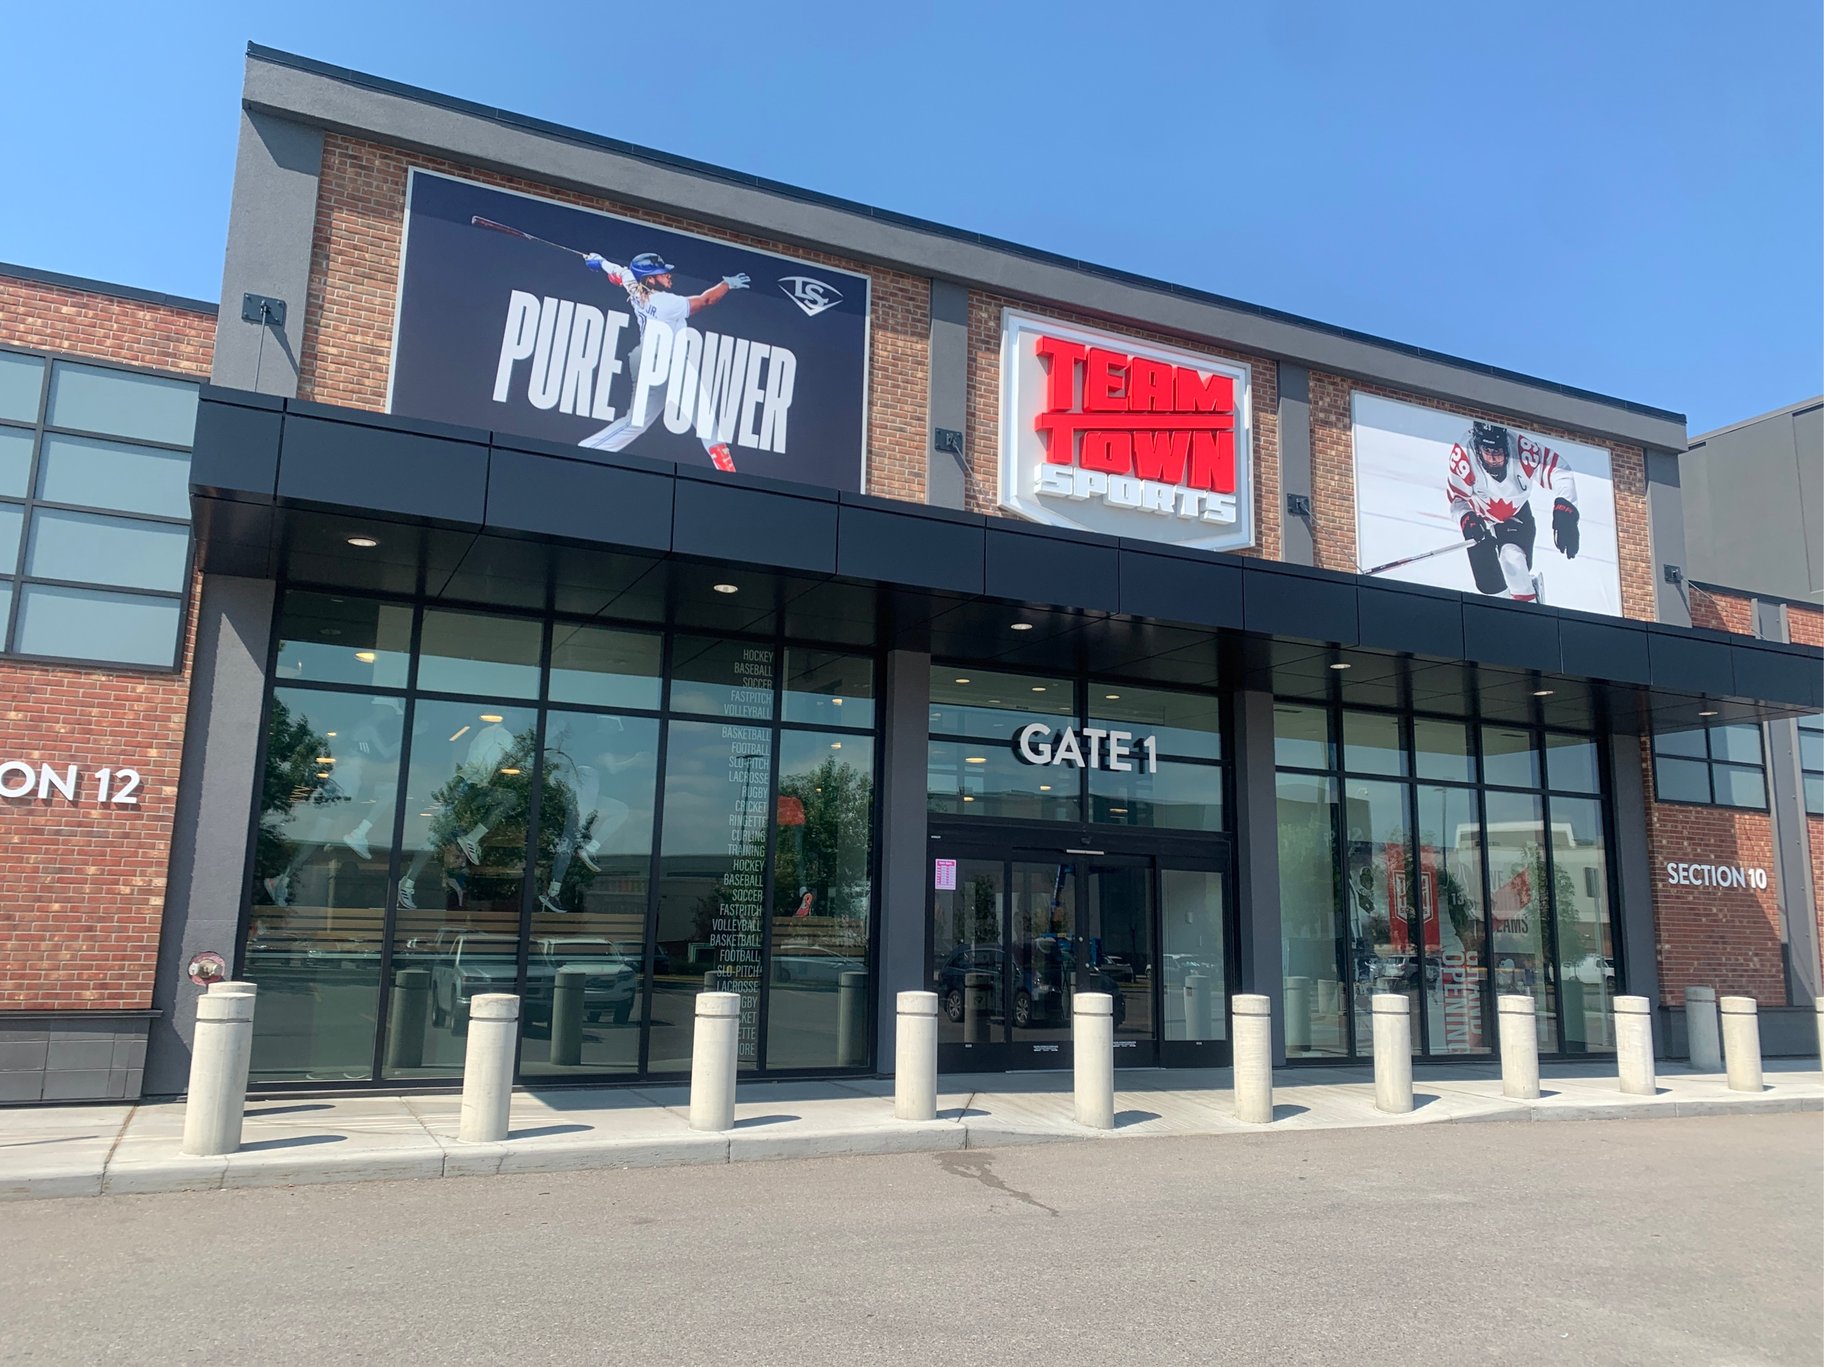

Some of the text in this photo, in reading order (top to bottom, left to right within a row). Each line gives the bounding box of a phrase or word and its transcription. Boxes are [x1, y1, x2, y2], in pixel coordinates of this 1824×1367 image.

[492, 290, 797, 455] PURE POWER
[1035, 336, 1235, 413] TEAM
[1034, 413, 1236, 494] TOWN
[1450, 447, 1470, 479] 29
[1034, 462, 1236, 525] SPORTS
[743, 649, 774, 663] HOCKEY
[734, 662, 773, 677] BASEBALL
[742, 677, 773, 690] SOCCER
[731, 690, 772, 704] FASTPITCH
[724, 704, 772, 719] VOLLEYBALL
[722, 727, 771, 741] BASKETBALL
[731, 741, 770, 756] FOOTBALL
[1020, 723, 1157, 774] GATE 1
[728, 770, 769, 785] LACROSSE
[95, 768, 140, 804] 12
[741, 786, 768, 799] RUGBY
[735, 800, 768, 814] CRICKET
[728, 814, 767, 828] RINGETTE
[731, 829, 766, 843] CURLING
[728, 843, 765, 858] TRAINING
[733, 859, 765, 873] HOCKEY
[723, 874, 763, 888] BASEBALL
[1667, 863, 1767, 889] SECTION 10
[732, 889, 763, 902] SOCCER
[719, 903, 762, 917] FASTPITCH
[712, 918, 761, 932] VOLLEYBALL
[709, 933, 761, 947] BASKETBALL
[719, 949, 760, 963] FOOTBALL
[716, 965, 760, 979] SLO-PITCH
[716, 980, 759, 993] LACROSSE
[740, 996, 758, 1009] GBY
[738, 1042, 756, 1056] ORE
